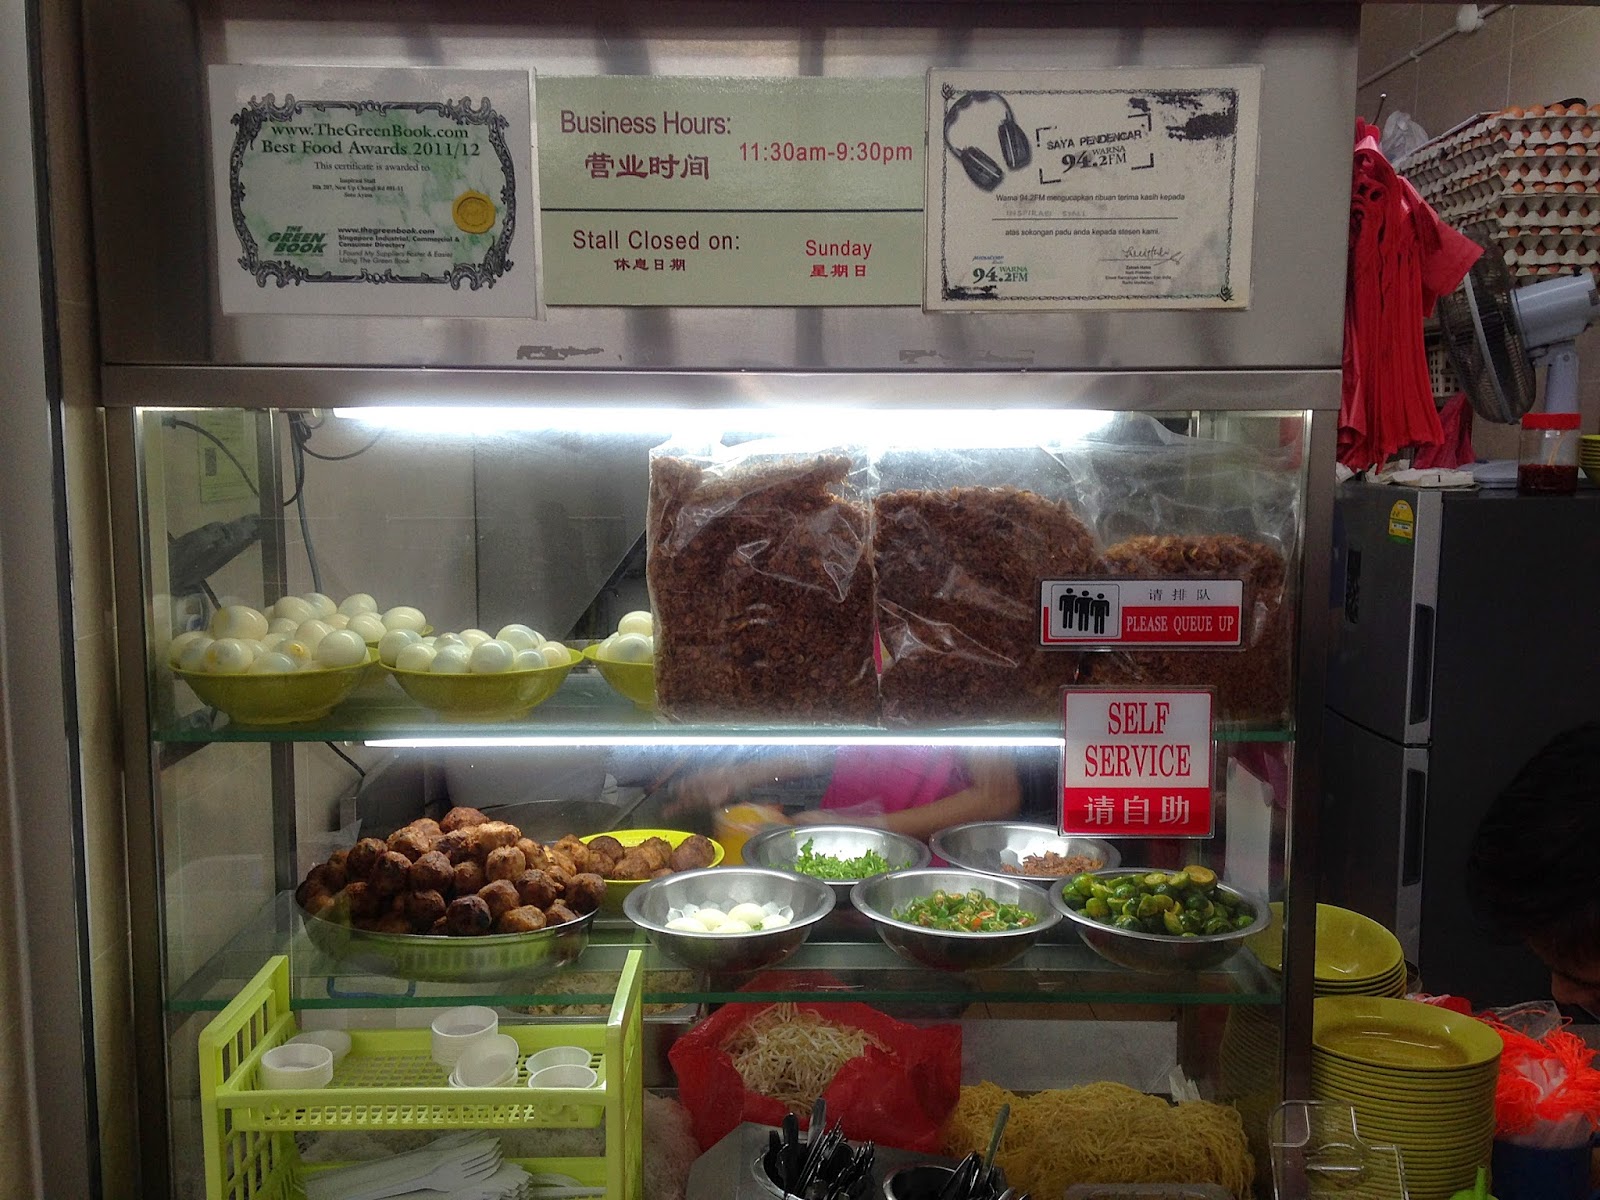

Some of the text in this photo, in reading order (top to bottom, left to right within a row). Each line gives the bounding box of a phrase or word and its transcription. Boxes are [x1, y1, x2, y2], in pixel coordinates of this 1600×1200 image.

[560, 109, 732, 135] Business Hours:
[271, 123, 469, 139] www.TheGreenBook.com
[1047, 129, 1142, 151] SAYA PENDENGAR
[261, 140, 480, 159] Best Food Awards 2011/12
[739, 141, 913, 165] 11:30am-9:30pm
[1091, 145, 1126, 156] WARNA
[314, 161, 431, 172] This certificate is awarded to
[585, 152, 710, 180] 营业时间
[1061, 150, 1127, 174] 94.2FM
[996, 194, 1018, 202] Warna
[1019, 194, 1046, 202] 94.2FM
[1046, 194, 1094, 203] mengucapkan
[1140, 193, 1159, 201] kasih
[1159, 193, 1186, 202] kepada
[267, 232, 326, 243] GREEN
[338, 226, 435, 235] www.thegreenbook.com
[1021, 228, 1054, 237] sokongan
[1054, 228, 1072, 237] padu
[1073, 228, 1091, 236] anda
[1091, 228, 1117, 237] kepada
[412, 235, 453, 243] Commercial
[572, 229, 740, 251] Stall Closed on:
[274, 243, 328, 253] BOOK
[805, 239, 872, 260] Sunday
[339, 257, 358, 265] Using
[613, 257, 686, 271] 休息日期
[999, 265, 1028, 273] WARNA
[810, 264, 867, 278] 星期日
[972, 266, 1028, 285] 94.2FM
[1149, 588, 1211, 601] 请排队
[1126, 615, 1235, 635] PLEASE QUEUE UP
[1108, 701, 1170, 735] SELF
[1084, 744, 1191, 777] SERVICE
[1083, 795, 1190, 825] 请自助
